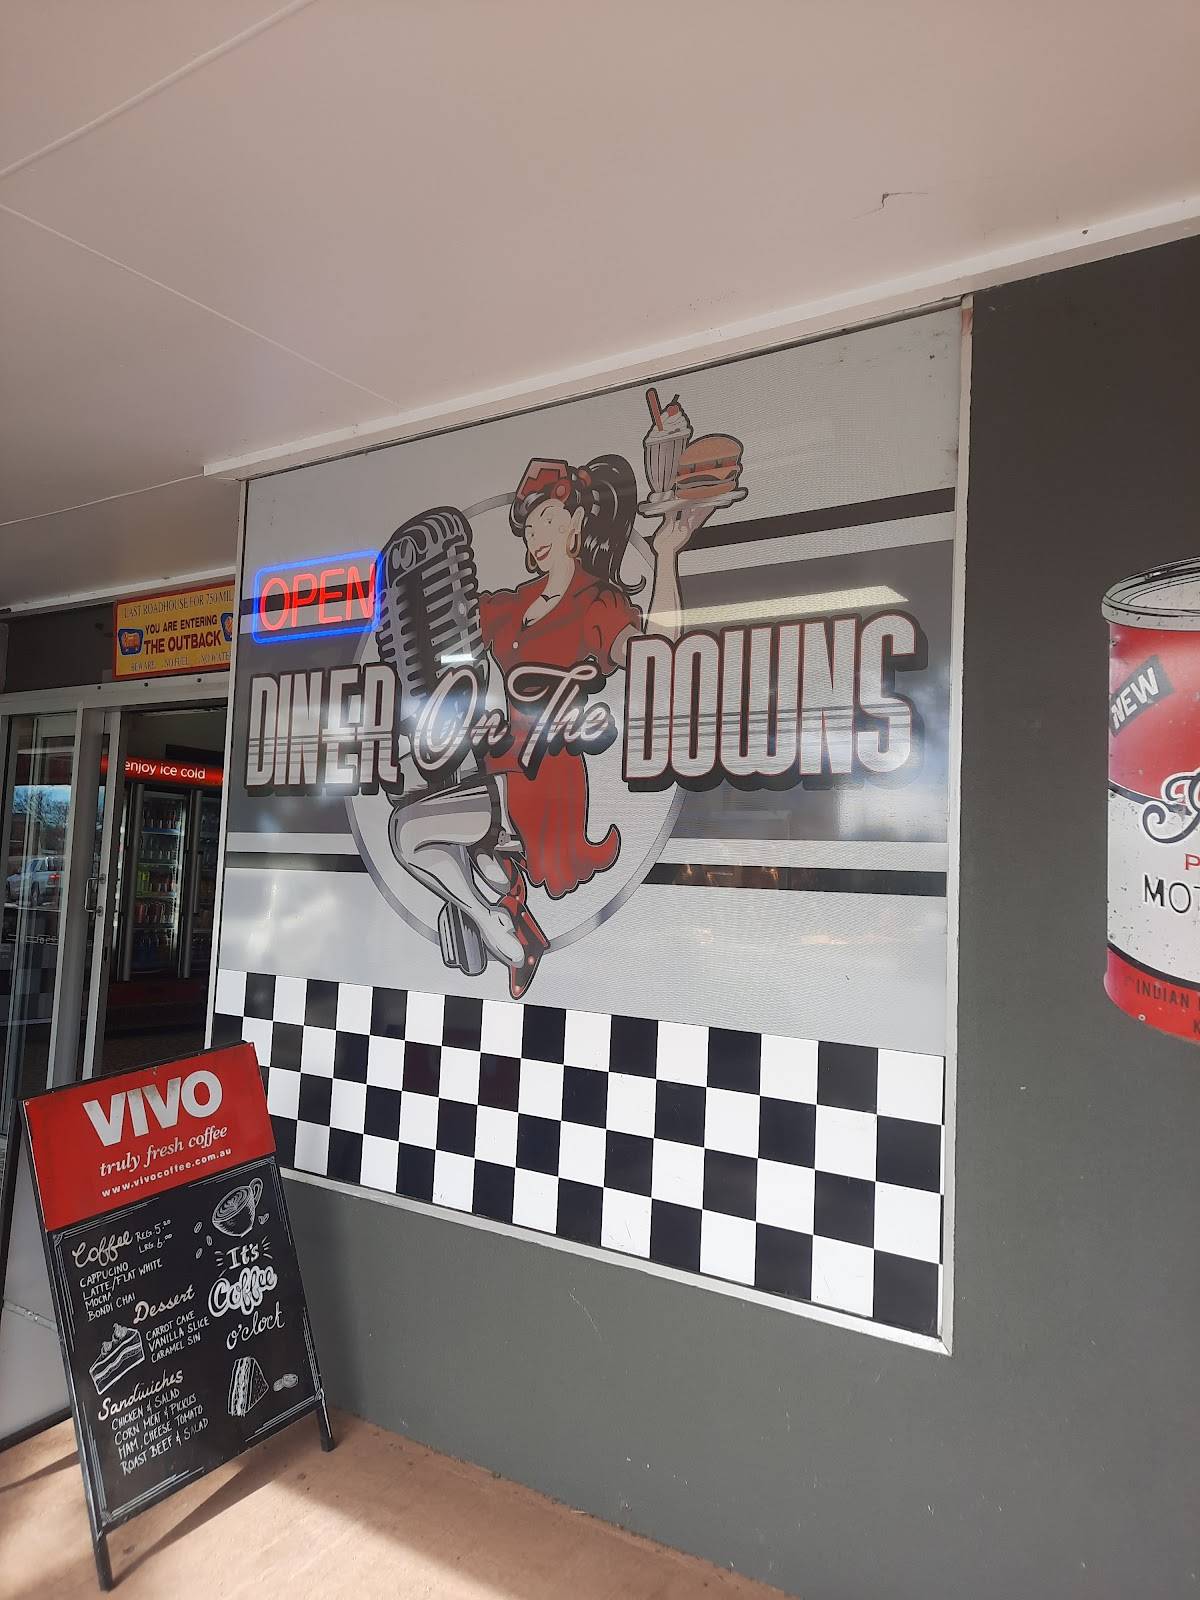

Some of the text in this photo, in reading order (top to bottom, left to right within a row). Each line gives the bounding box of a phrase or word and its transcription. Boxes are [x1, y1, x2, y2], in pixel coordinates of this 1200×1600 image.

[143, 595, 189, 616] ROADHOUSE
[189, 595, 204, 607] FOR
[260, 562, 376, 631] OPEN
[144, 630, 222, 655] THE OUTBACK
[145, 615, 218, 635] YOU ARE ENTERING
[246, 612, 918, 788] DINER On The DOWNS
[1111, 667, 1159, 729] NEW
[125, 760, 206, 780] enjoy ice cold
[1136, 979, 1190, 1008] INDIAN
[82, 1070, 223, 1147] VIVO
[100, 1125, 228, 1177] truly fresh coffee
[101, 1148, 232, 1198] www.vivocoffee.com.au
[72, 1230, 134, 1268] Coffee
[226, 1243, 260, 1270] It's
[80, 1261, 129, 1288] CAPPUCINO
[82, 1258, 163, 1301] LATTE/FLAT WHITE
[208, 1265, 278, 1318] Coffee
[84, 1291, 112, 1311] MOCHA
[87, 1292, 136, 1322] BONDI CHAI
[133, 1284, 196, 1325] Dessert
[145, 1310, 196, 1341] CARROT CAKE
[148, 1316, 210, 1353] VANILLA SLICE
[151, 1332, 201, 1363] CARAMEL SIN
[98, 1369, 184, 1421] Sandwiches
[111, 1405, 144, 1431] CHICKEN
[154, 1388, 180, 1409] SALAD
[114, 1422, 140, 1446] CORN
[143, 1411, 161, 1430] MEAT
[143, 1420, 172, 1446] CHEESE
[174, 1404, 203, 1427] TOMATO
[120, 1449, 147, 1476] ROAST
[148, 1434, 172, 1458] BEEF
[183, 1417, 209, 1441] SALAD
